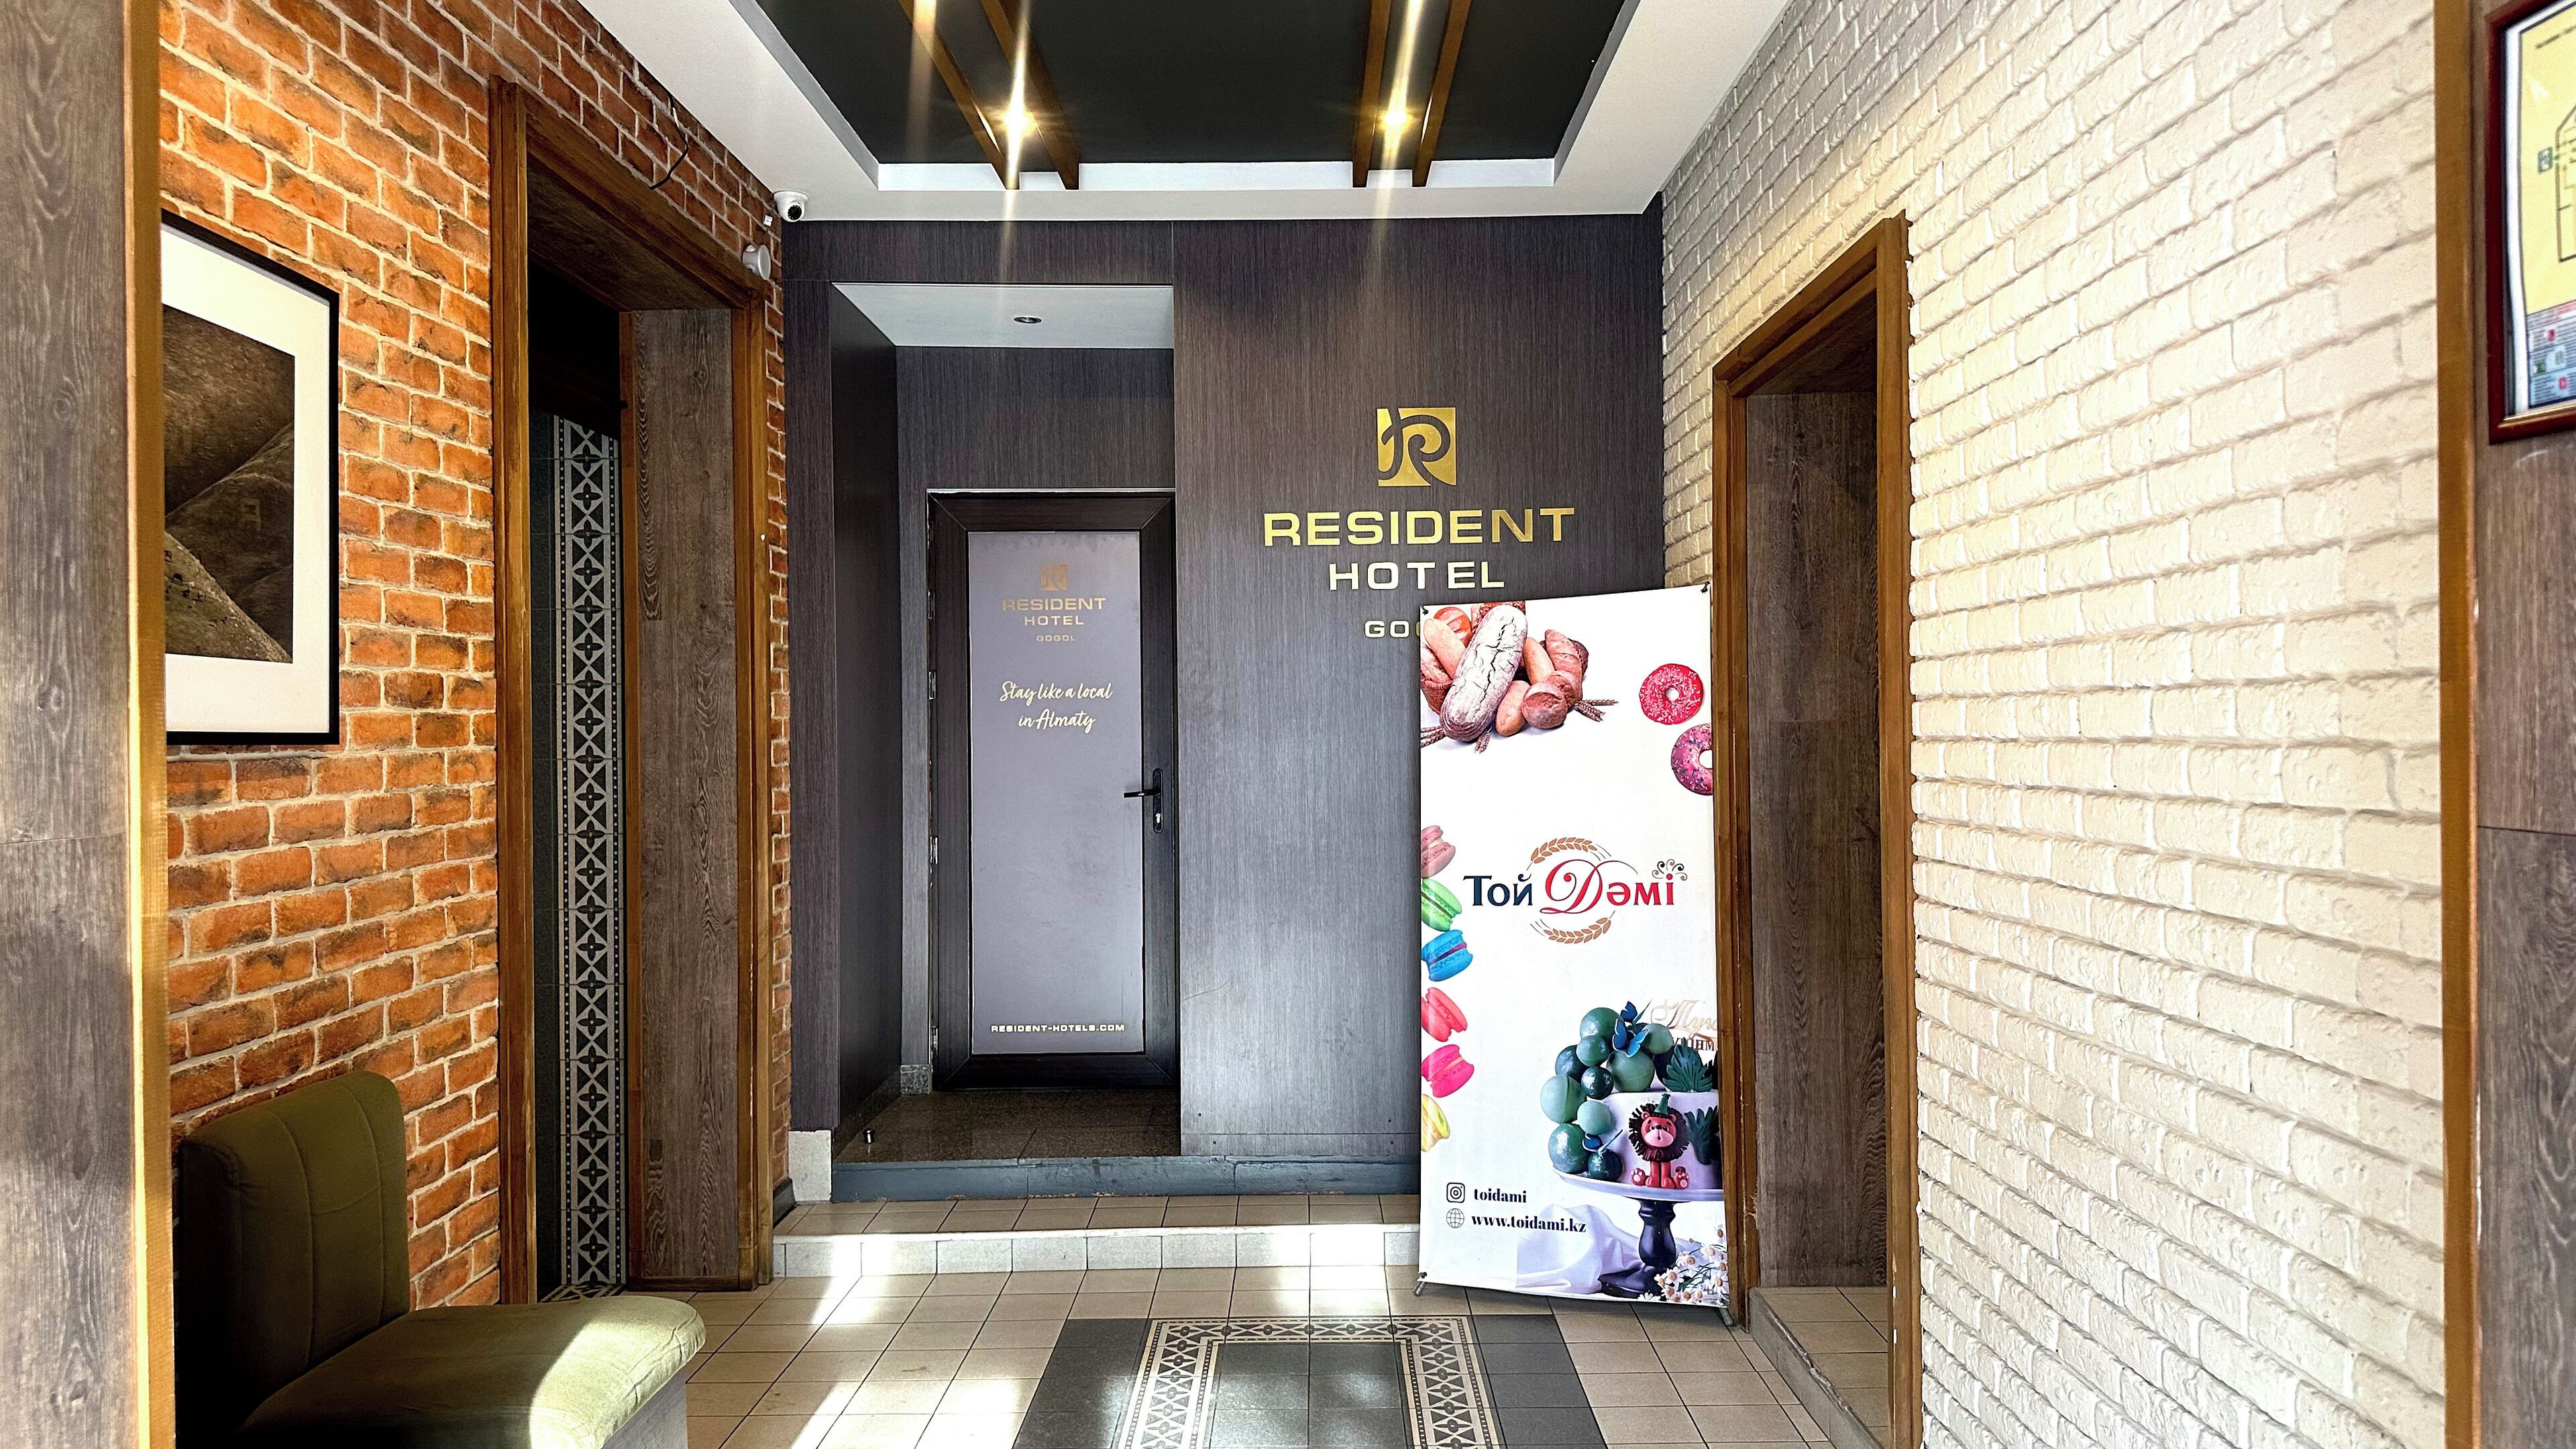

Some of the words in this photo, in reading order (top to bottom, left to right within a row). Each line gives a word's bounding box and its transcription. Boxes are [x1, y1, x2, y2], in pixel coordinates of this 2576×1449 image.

[1264, 507, 1575, 546] RESIDENT
[1329, 561, 1505, 590] HOTEL
[1002, 597, 1106, 611] RESIDENT
[1024, 615, 1084, 626] HOTEL
[1364, 620, 1420, 638] GO
[1000, 680, 1036, 706] Stay
[1037, 683, 1065, 700] like
[1065, 688, 1075, 699] a
[1077, 682, 1113, 699] local
[1018, 715, 1036, 728] in
[1036, 708, 1096, 734] Almaty
[1463, 873, 1533, 906] Той
[991, 1024, 1125, 1033] RESIDENT-HOTELS.COM
[1474, 1188, 1527, 1203] toidami
[1471, 1216, 1587, 1233] www.toidami.kz
